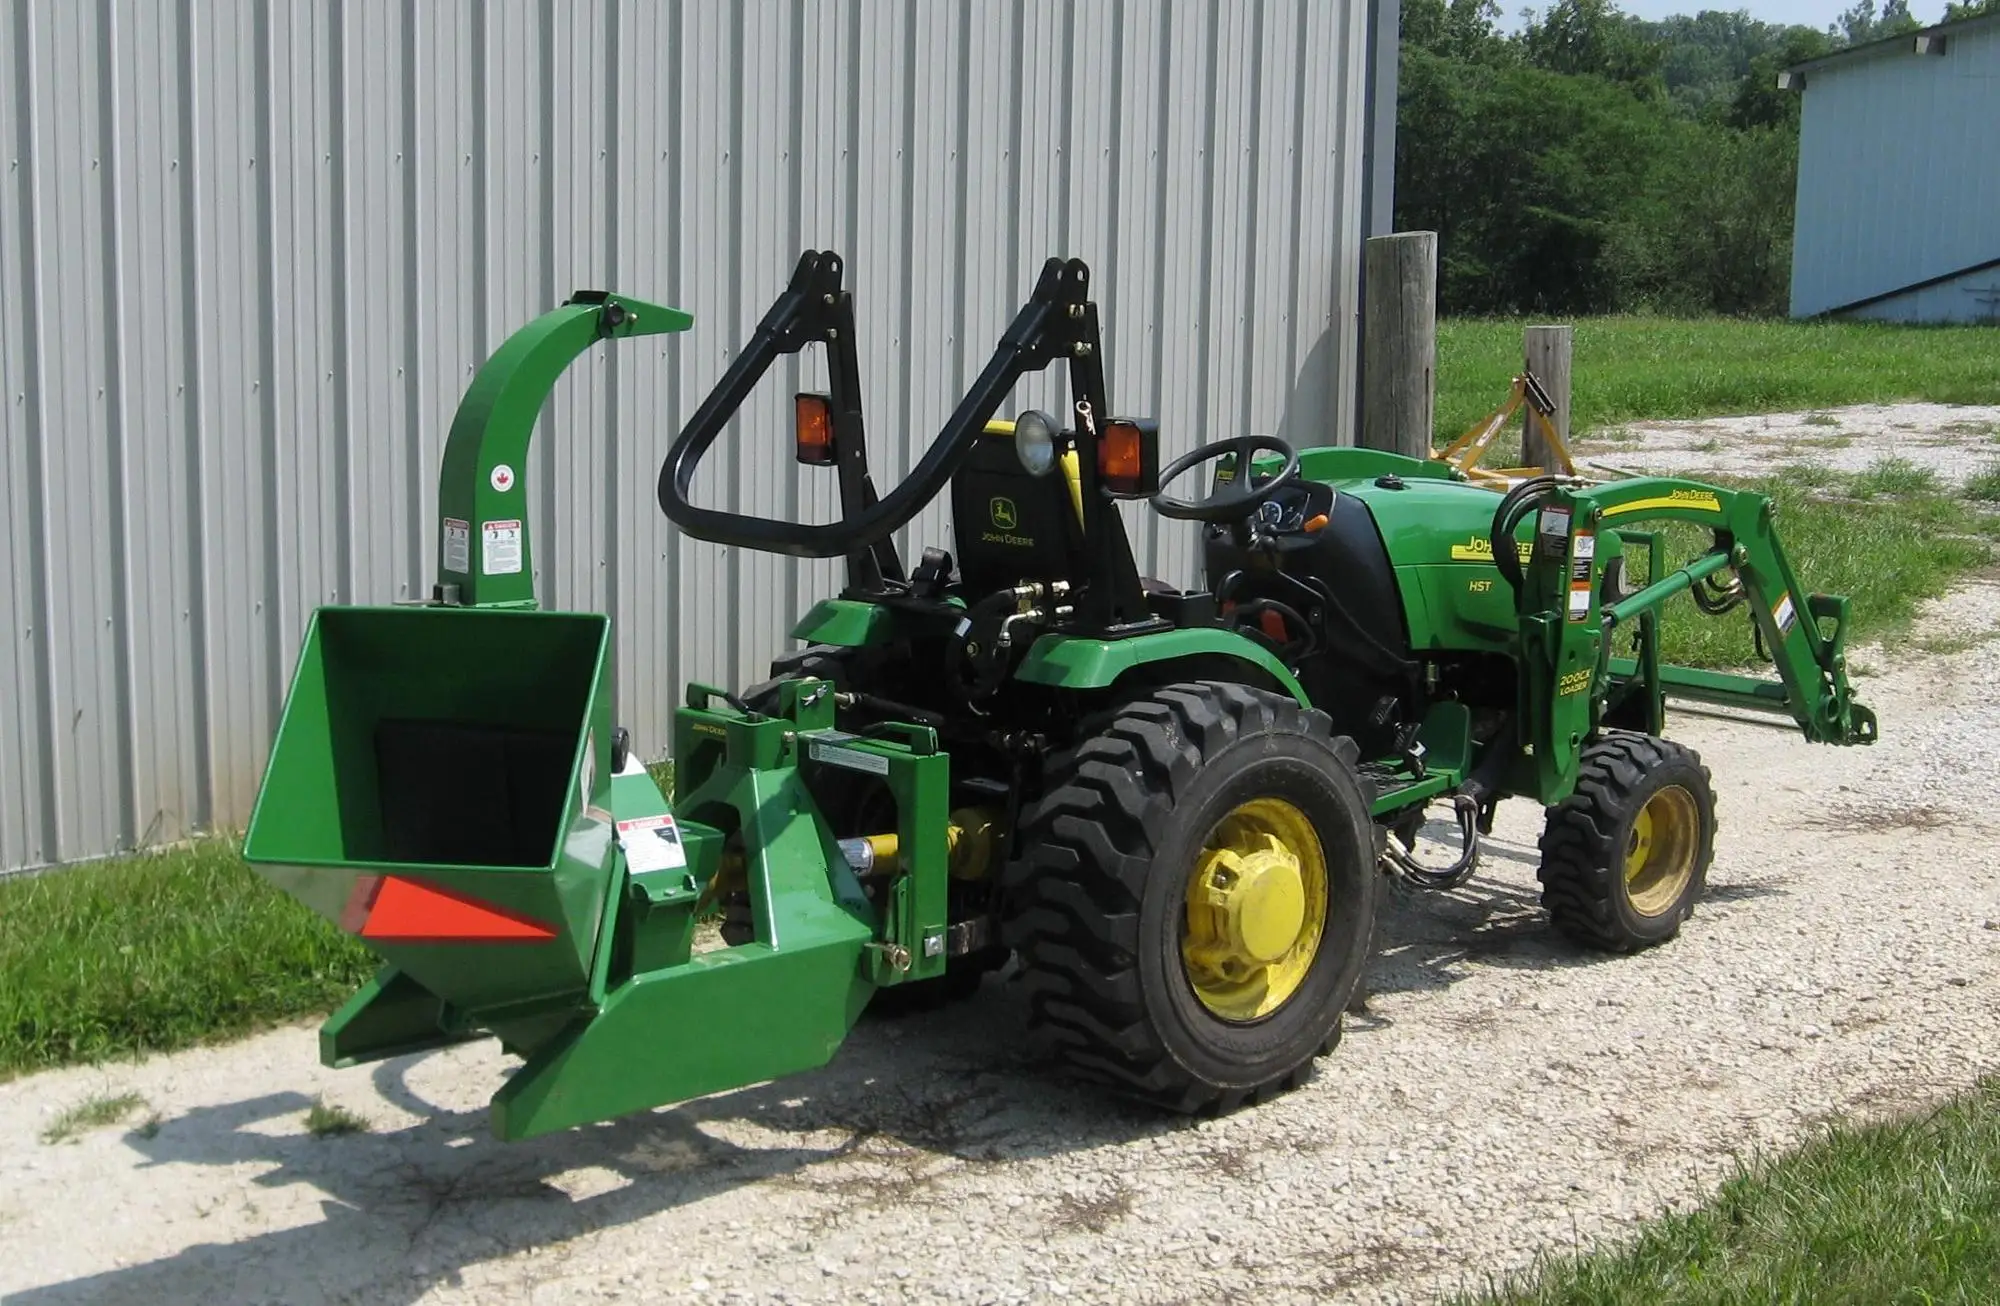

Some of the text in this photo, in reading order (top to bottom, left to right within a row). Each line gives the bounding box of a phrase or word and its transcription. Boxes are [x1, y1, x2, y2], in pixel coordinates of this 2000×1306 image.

[1669, 489, 1715, 501] JOHN DEERE
[982, 531, 1034, 547] JOHN DEERE
[1465, 535, 1492, 553] JOH
[1469, 581, 1492, 592] HST
[1560, 681, 1588, 696] LOADER
